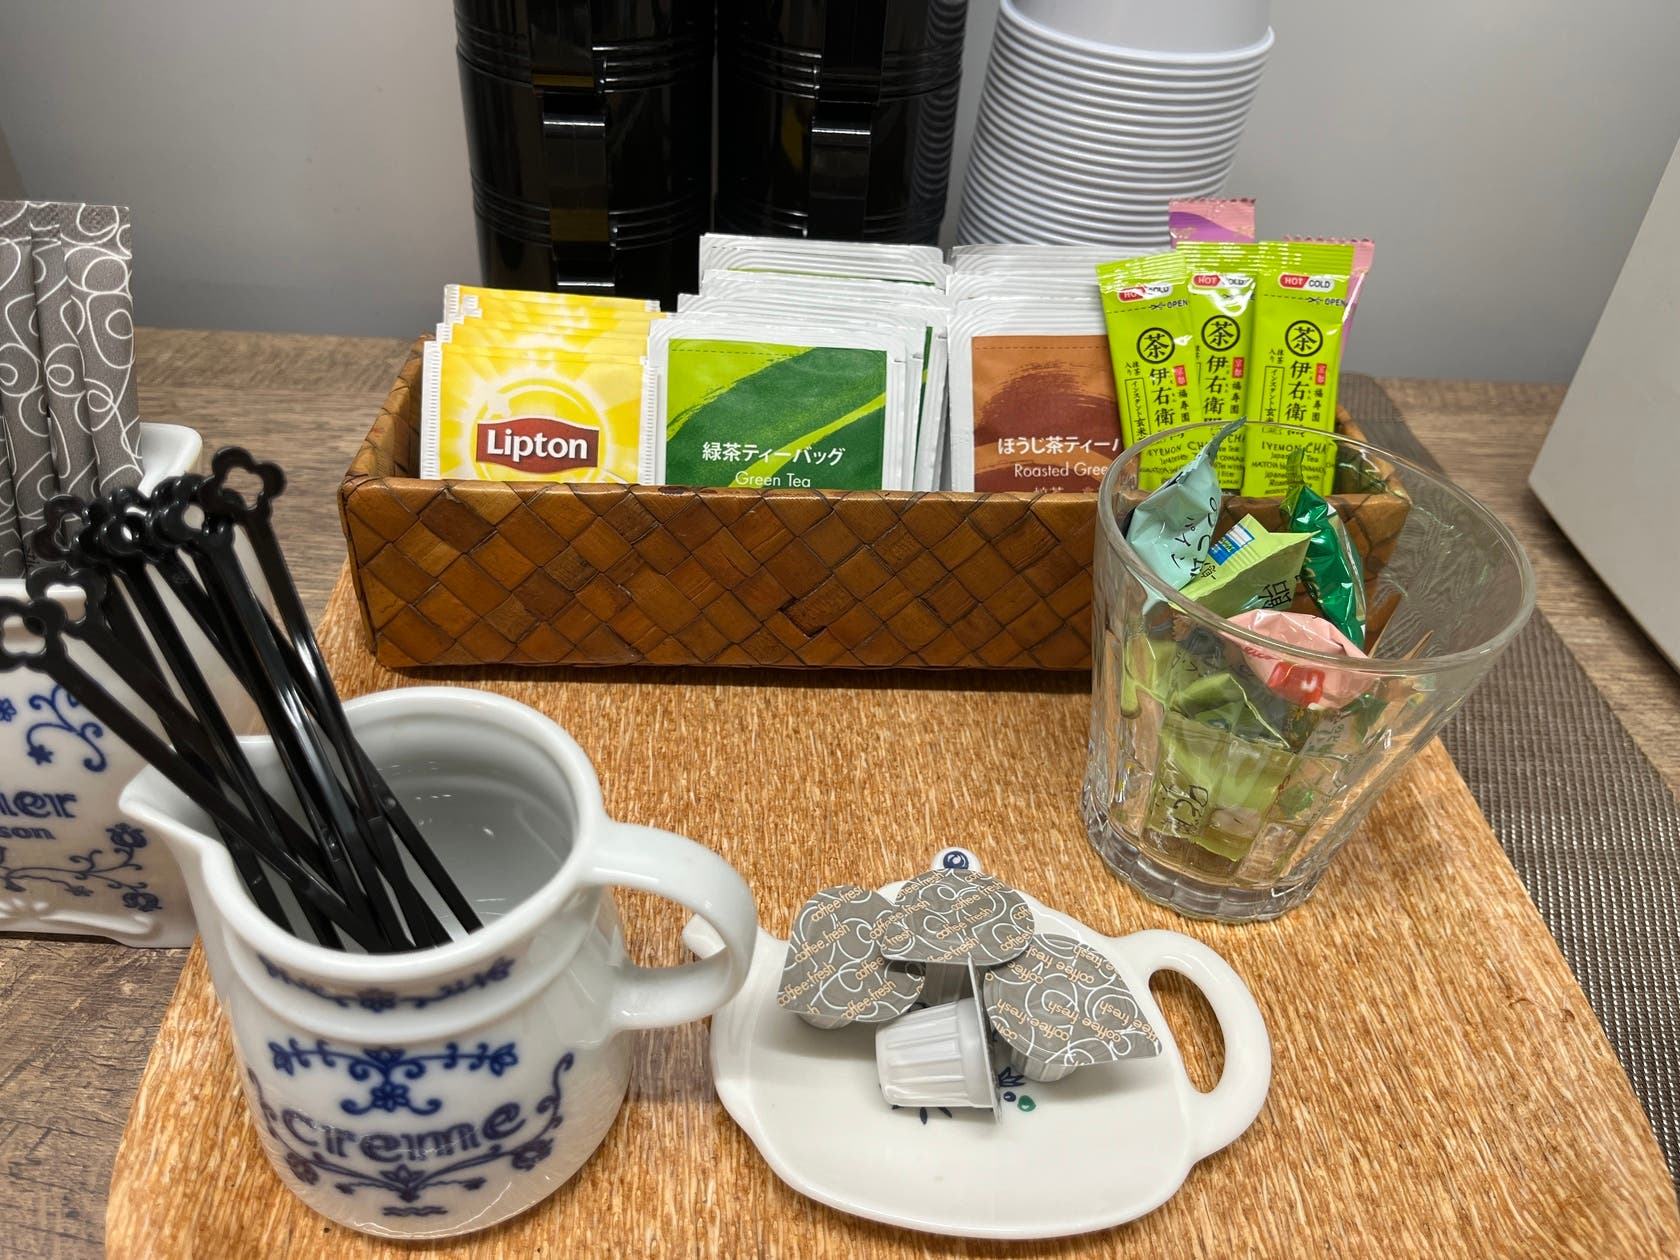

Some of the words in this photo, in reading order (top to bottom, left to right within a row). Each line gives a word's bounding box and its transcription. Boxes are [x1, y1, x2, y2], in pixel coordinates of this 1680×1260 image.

[1198, 276, 1218, 284] HOT
[1284, 276, 1304, 285] HOT
[1308, 279, 1331, 289] COLD
[1166, 299, 1189, 309] OPEN
[1143, 333, 1170, 359] 茶
[1207, 320, 1235, 346] 茶
[1291, 326, 1318, 352] 茶
[1149, 367, 1176, 427] 伊右衛
[1203, 355, 1229, 422] 伊右衛
[1285, 360, 1312, 422] 伊右衛
[487, 428, 588, 463] Lipton
[702, 441, 846, 466] 緑茶ティーバッグ
[735, 470, 781, 487] Green
[786, 472, 811, 488] Tea
[1014, 461, 1069, 478] Roasted
[1074, 461, 1108, 477] Gree
[1170, 515, 1196, 569] パイン
[811, 898, 841, 922] coffee
[838, 886, 865, 904] fresh
[901, 898, 931, 917] fresh
[951, 891, 981, 912] coffee
[978, 880, 1005, 897] fresh
[935, 920, 968, 940] coffee
[964, 905, 993, 924] fresh
[795, 941, 825, 963] coffee
[822, 921, 851, 944] fresh
[884, 927, 915, 946] fresh
[949, 936, 980, 956] fresh
[1000, 933, 1031, 952] coffee
[855, 956, 885, 981] coffee
[1073, 944, 1103, 971] fresh
[777, 978, 810, 1007] coffee
[807, 962, 837, 985] fresh
[1055, 960, 1095, 984] coffee
[868, 978, 897, 1002] fresh
[997, 999, 1029, 1026] fresh
[1047, 1001, 1081, 1026] fresh
[1098, 1000, 1132, 1027] fresh
[1029, 1017, 1070, 1042] coffee
[1082, 1017, 1122, 1043] coffee
[282, 1102, 527, 1163] Creme
